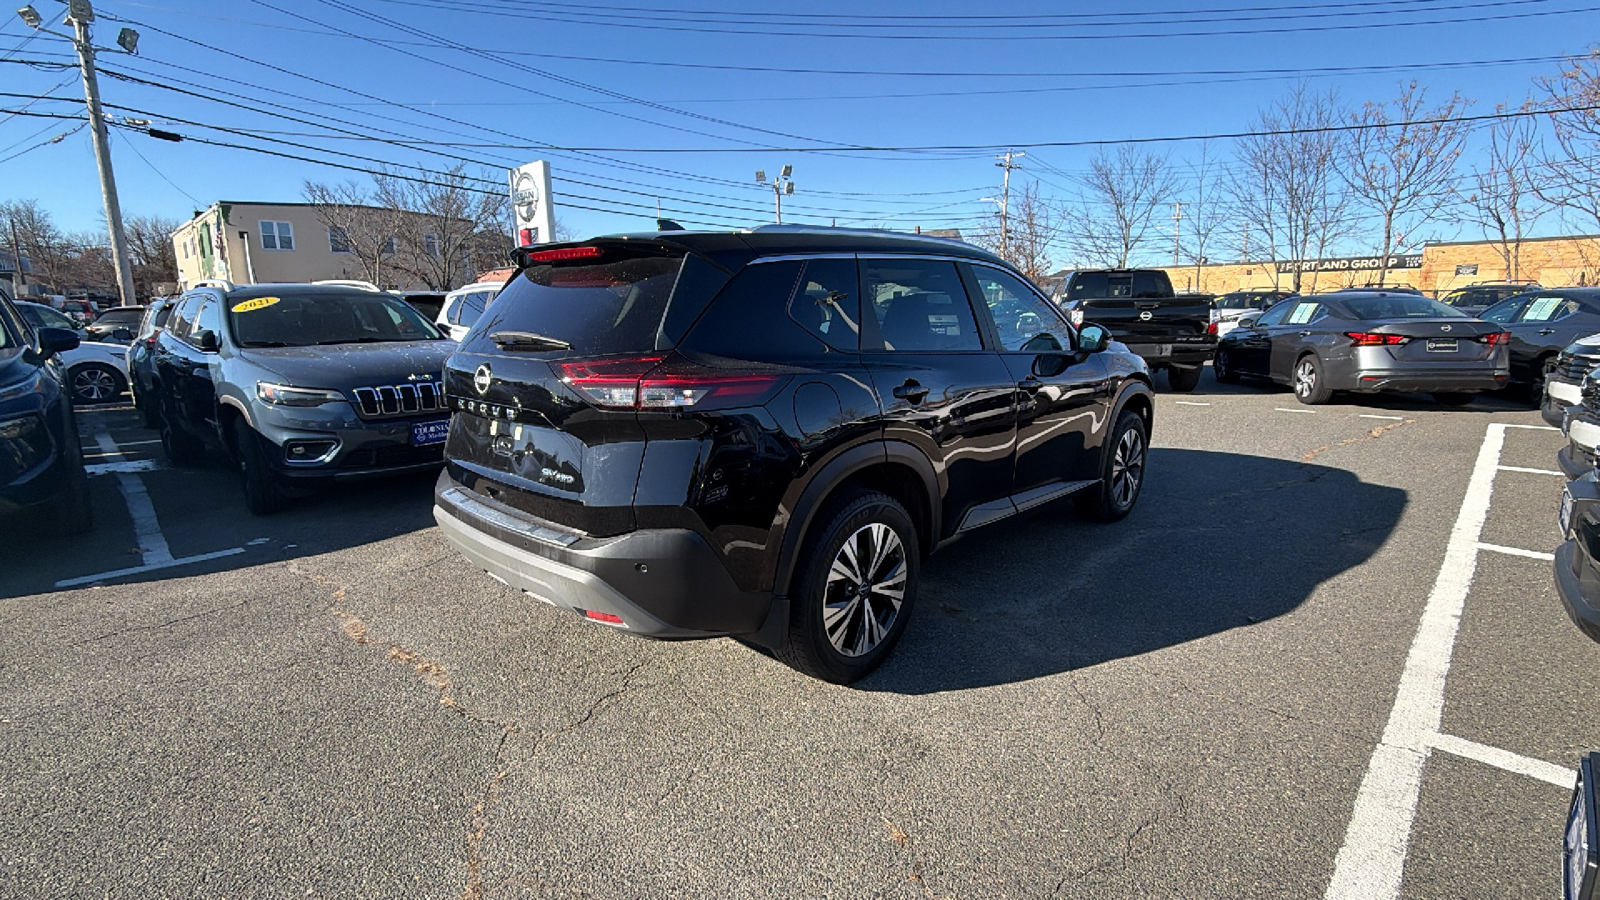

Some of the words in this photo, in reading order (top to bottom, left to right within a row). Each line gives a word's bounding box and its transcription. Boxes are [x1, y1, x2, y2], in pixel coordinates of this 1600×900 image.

[242, 298, 268, 310] 2021
[458, 399, 515, 420] ROGUE
[414, 424, 449, 434] COLONIA
